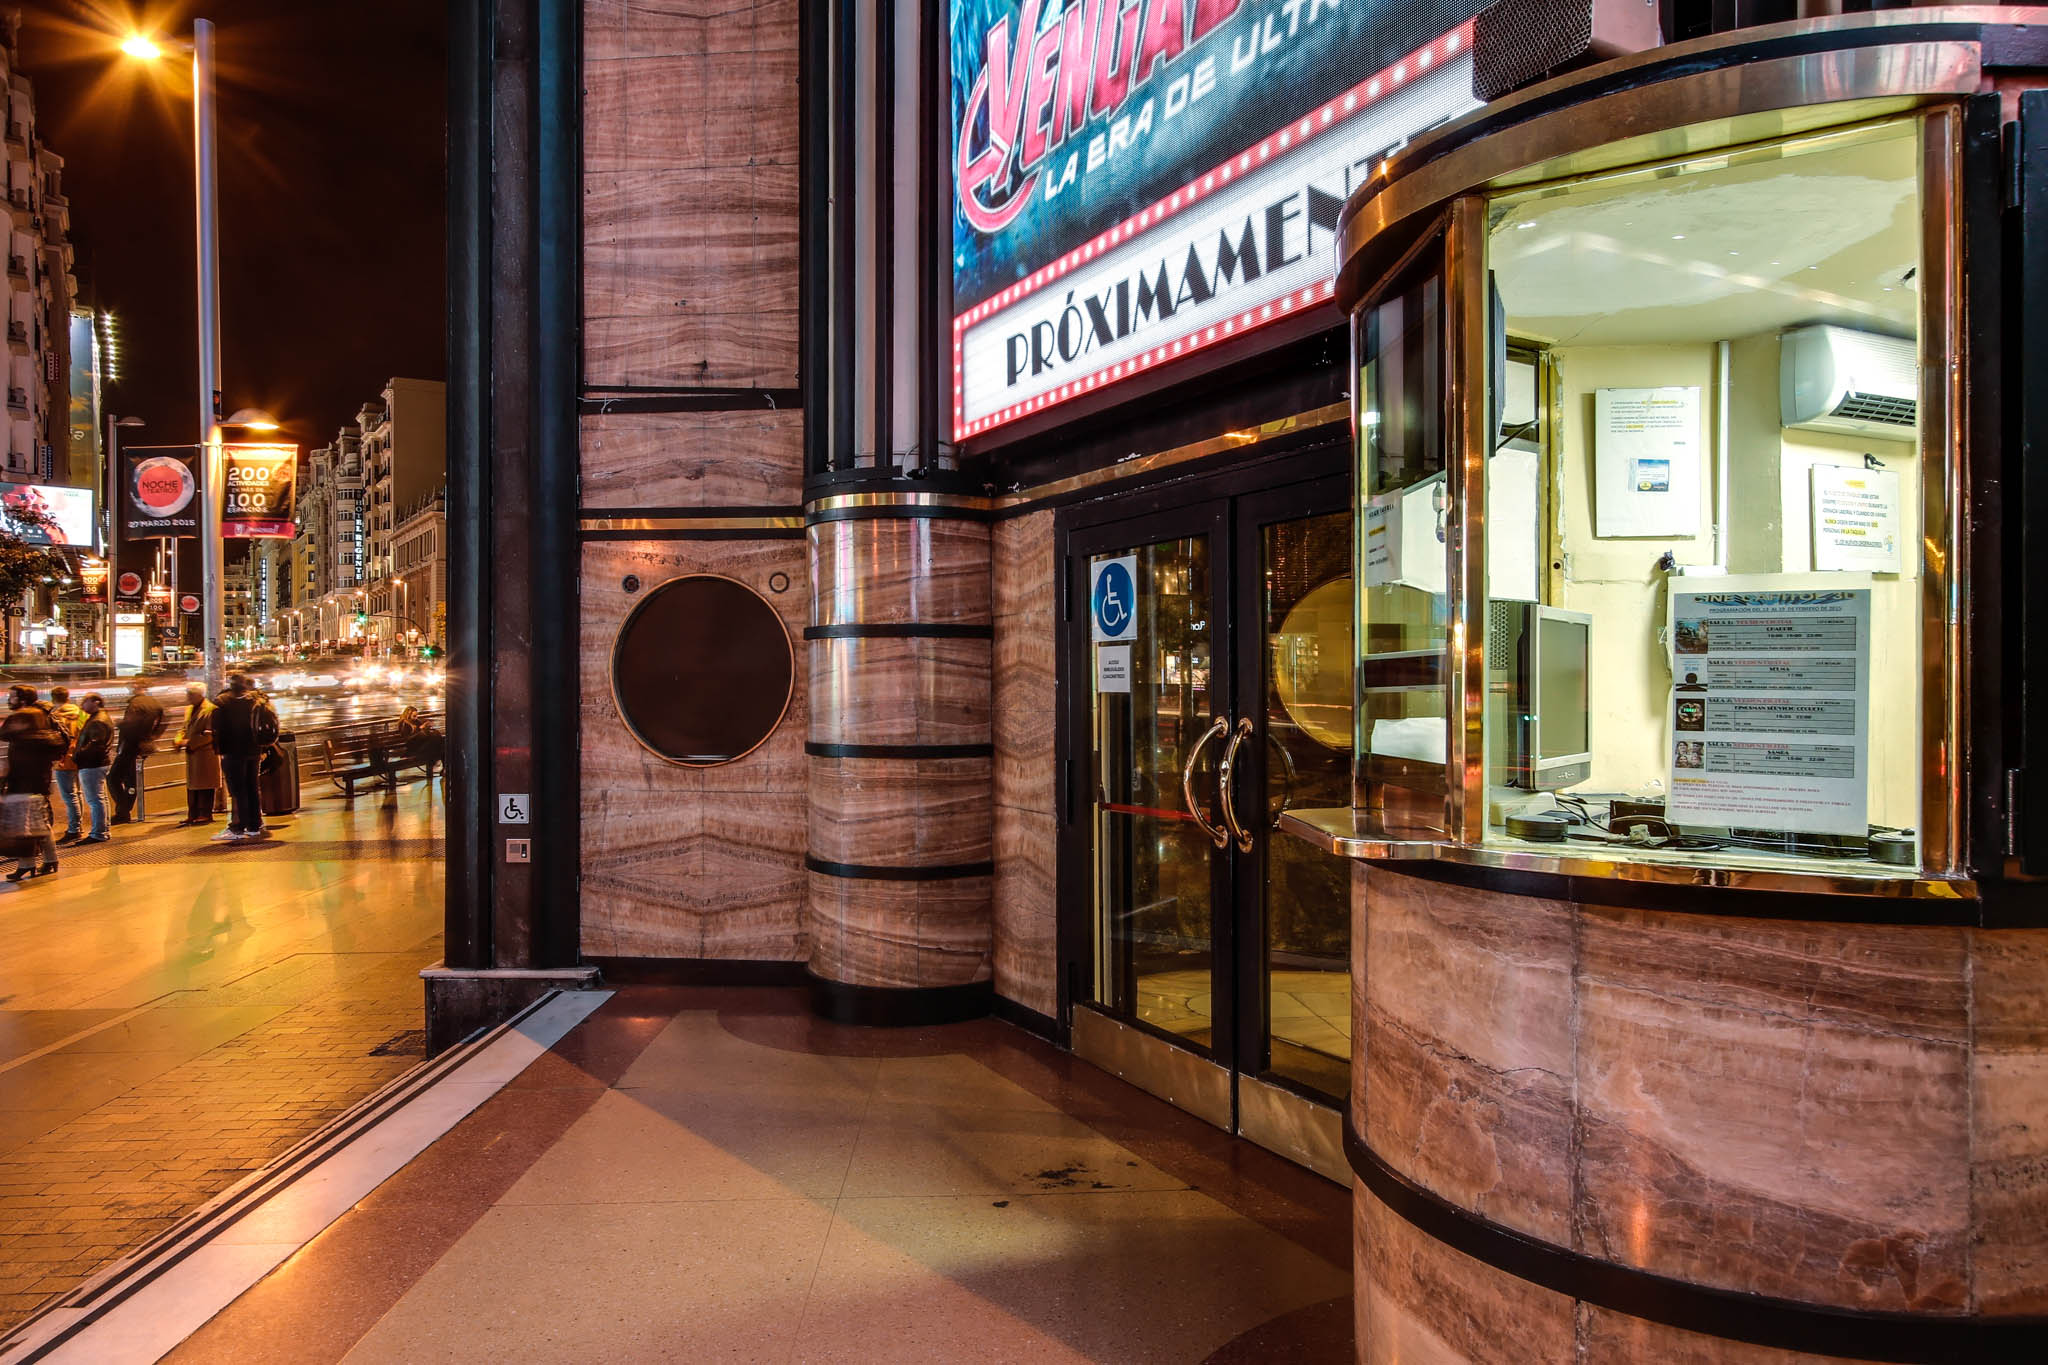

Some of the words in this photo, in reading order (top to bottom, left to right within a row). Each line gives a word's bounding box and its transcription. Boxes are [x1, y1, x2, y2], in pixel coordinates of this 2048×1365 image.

[1045, 151, 1079, 201] LA
[1086, 99, 1154, 173] ERA
[1165, 56, 1216, 120] DE
[1006, 113, 1451, 387] PRÓXIMAMEN
[228, 466, 269, 480] 200
[142, 480, 178, 488] NOCHE
[228, 493, 266, 507] 100
